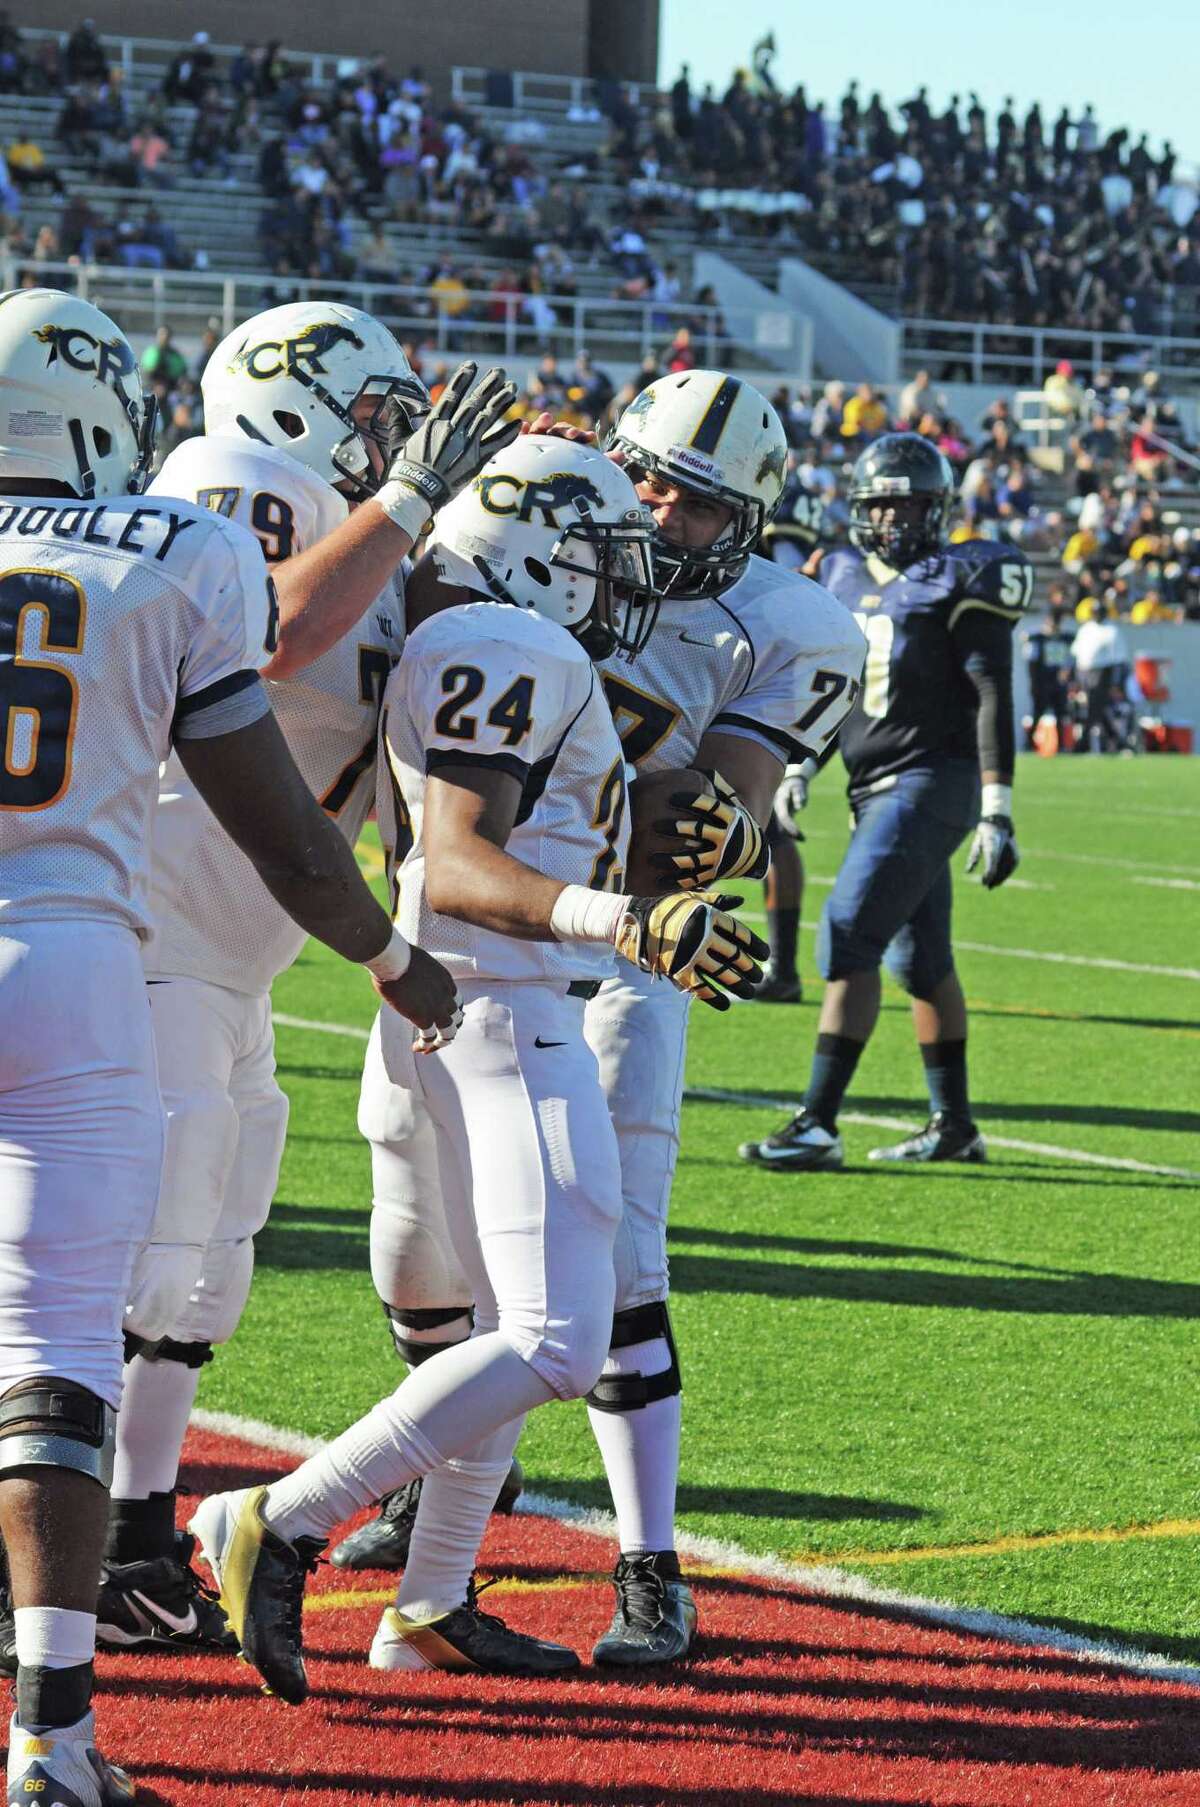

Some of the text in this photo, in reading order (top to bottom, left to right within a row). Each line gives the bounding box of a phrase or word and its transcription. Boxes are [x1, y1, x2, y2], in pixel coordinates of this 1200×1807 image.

[246, 339, 329, 380] CR
[399, 464, 437, 491] Riddell
[677, 451, 714, 473] Riddell
[480, 473, 561, 530] CR
[1000, 563, 1033, 608] 51
[0, 567, 87, 813] 6
[434, 664, 536, 746] 24
[23, 1779, 47, 1793] 66
